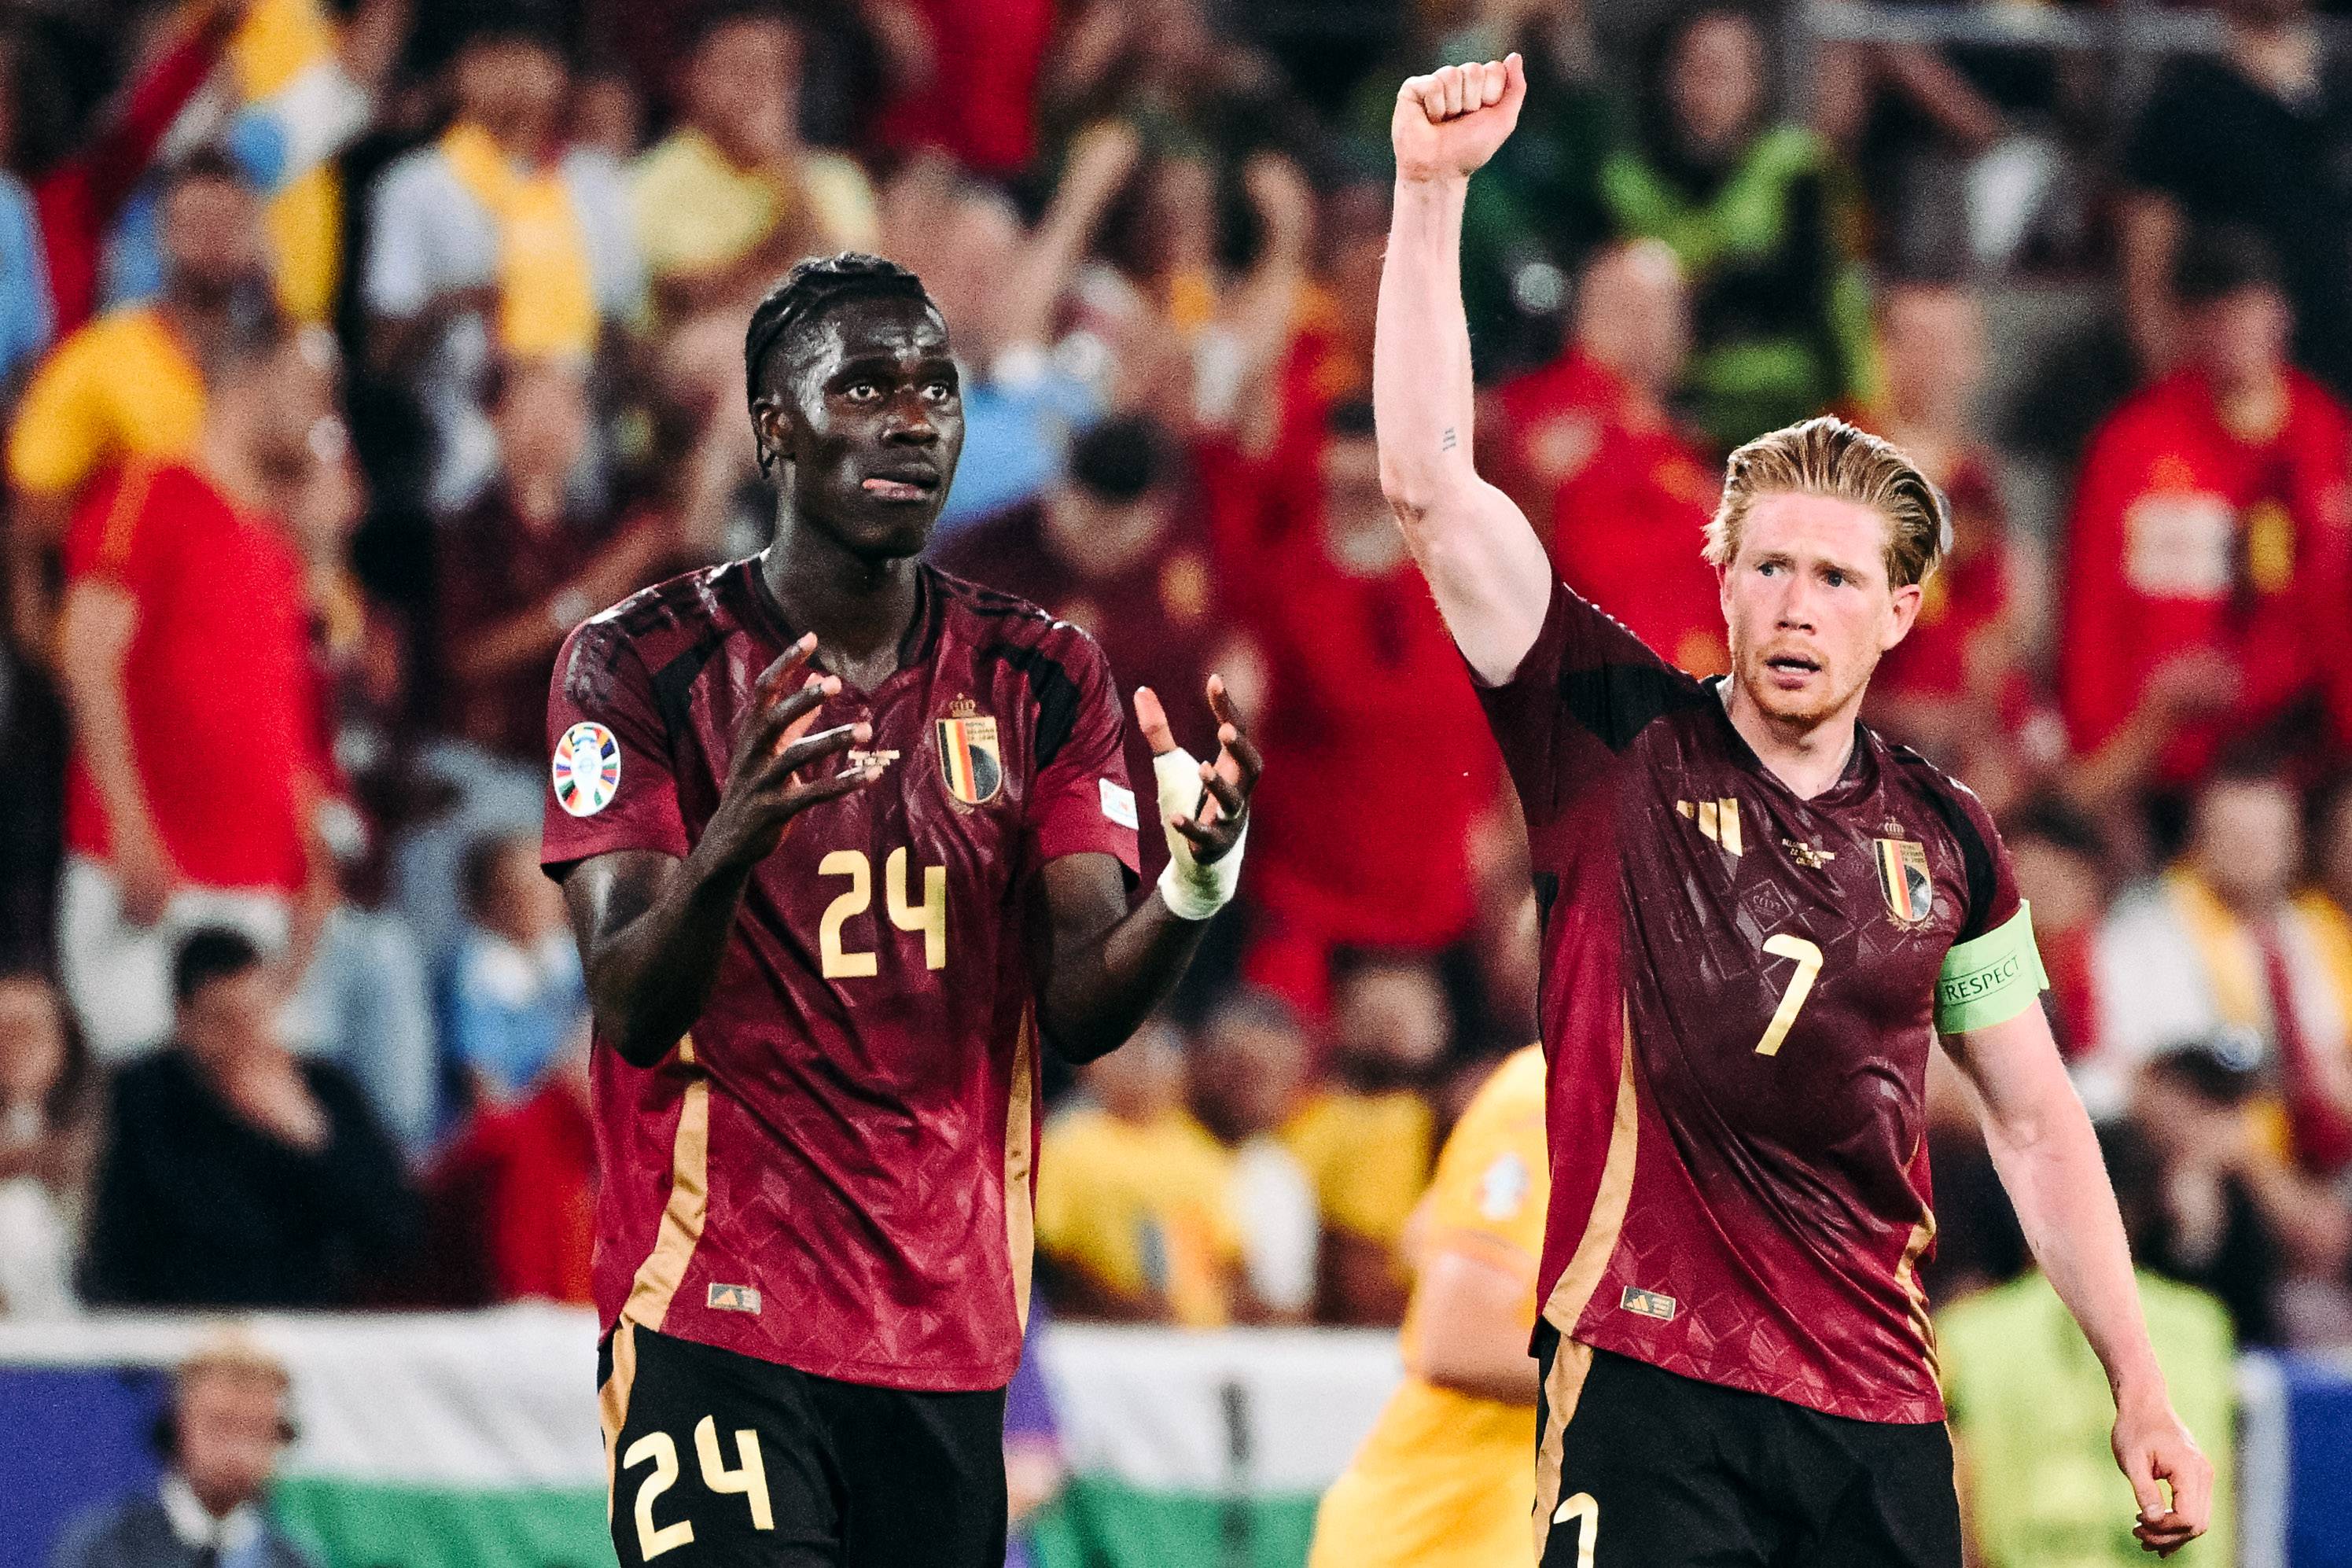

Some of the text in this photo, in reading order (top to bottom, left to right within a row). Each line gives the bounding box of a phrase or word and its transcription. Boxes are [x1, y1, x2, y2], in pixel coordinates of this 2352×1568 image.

[818, 845, 946, 979] 24
[1754, 933, 1824, 1057] 7
[1945, 955, 2019, 1001] RESPECT
[624, 1415, 775, 1562] 24
